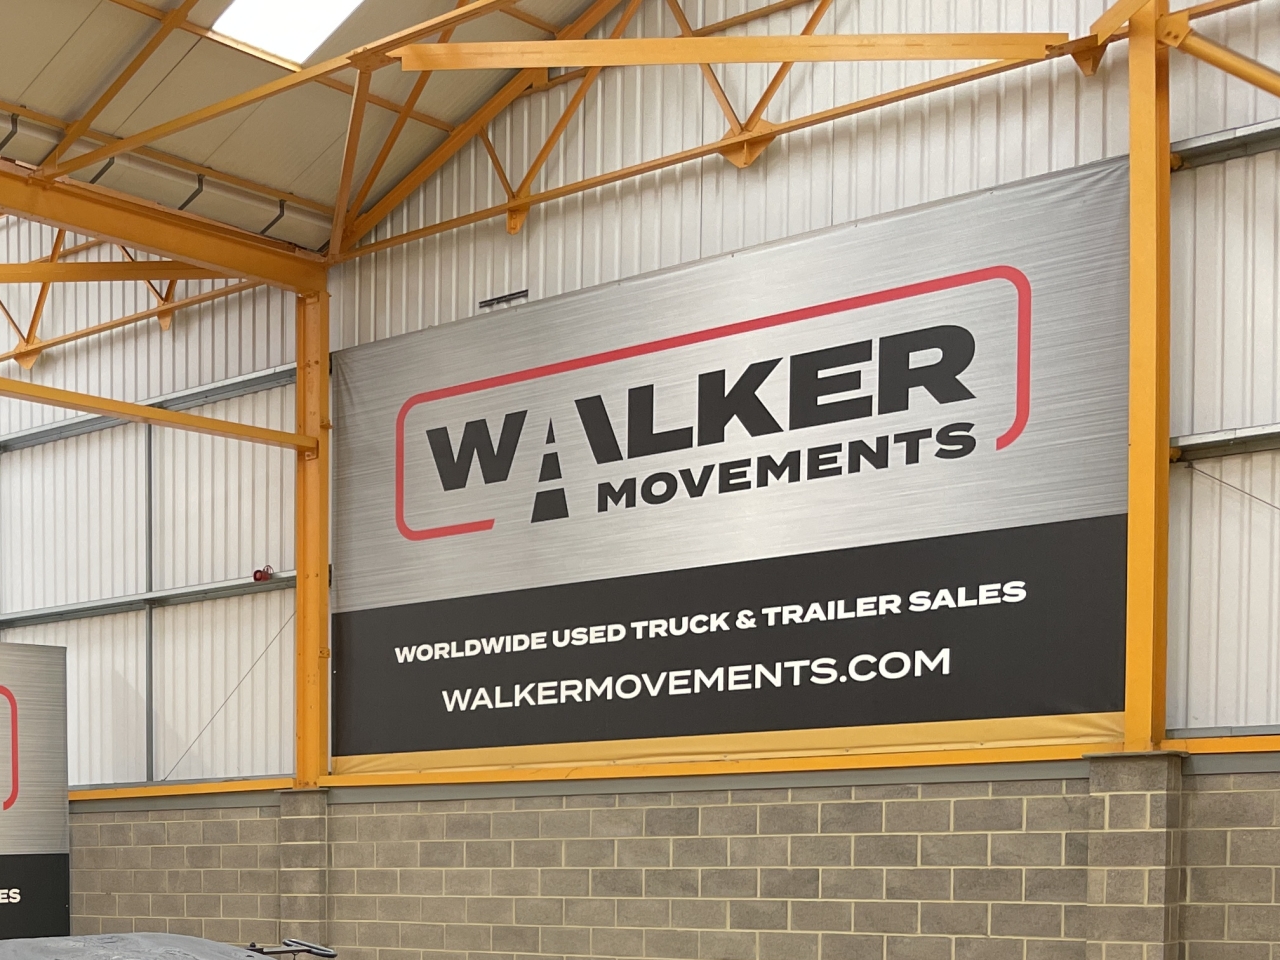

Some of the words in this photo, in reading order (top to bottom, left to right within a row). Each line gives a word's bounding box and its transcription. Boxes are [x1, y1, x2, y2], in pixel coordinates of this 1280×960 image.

[425, 324, 977, 524] WALKER
[597, 422, 977, 513] MOVEMENTS
[394, 631, 547, 664] WORLDWIDE
[552, 623, 627, 648] USED
[630, 611, 731, 640] TRUCK
[735, 609, 757, 630] &
[761, 594, 902, 627] TRAILER
[908, 580, 1027, 612] SALES
[441, 647, 951, 712] WALKERMOVEMENTS.COM
